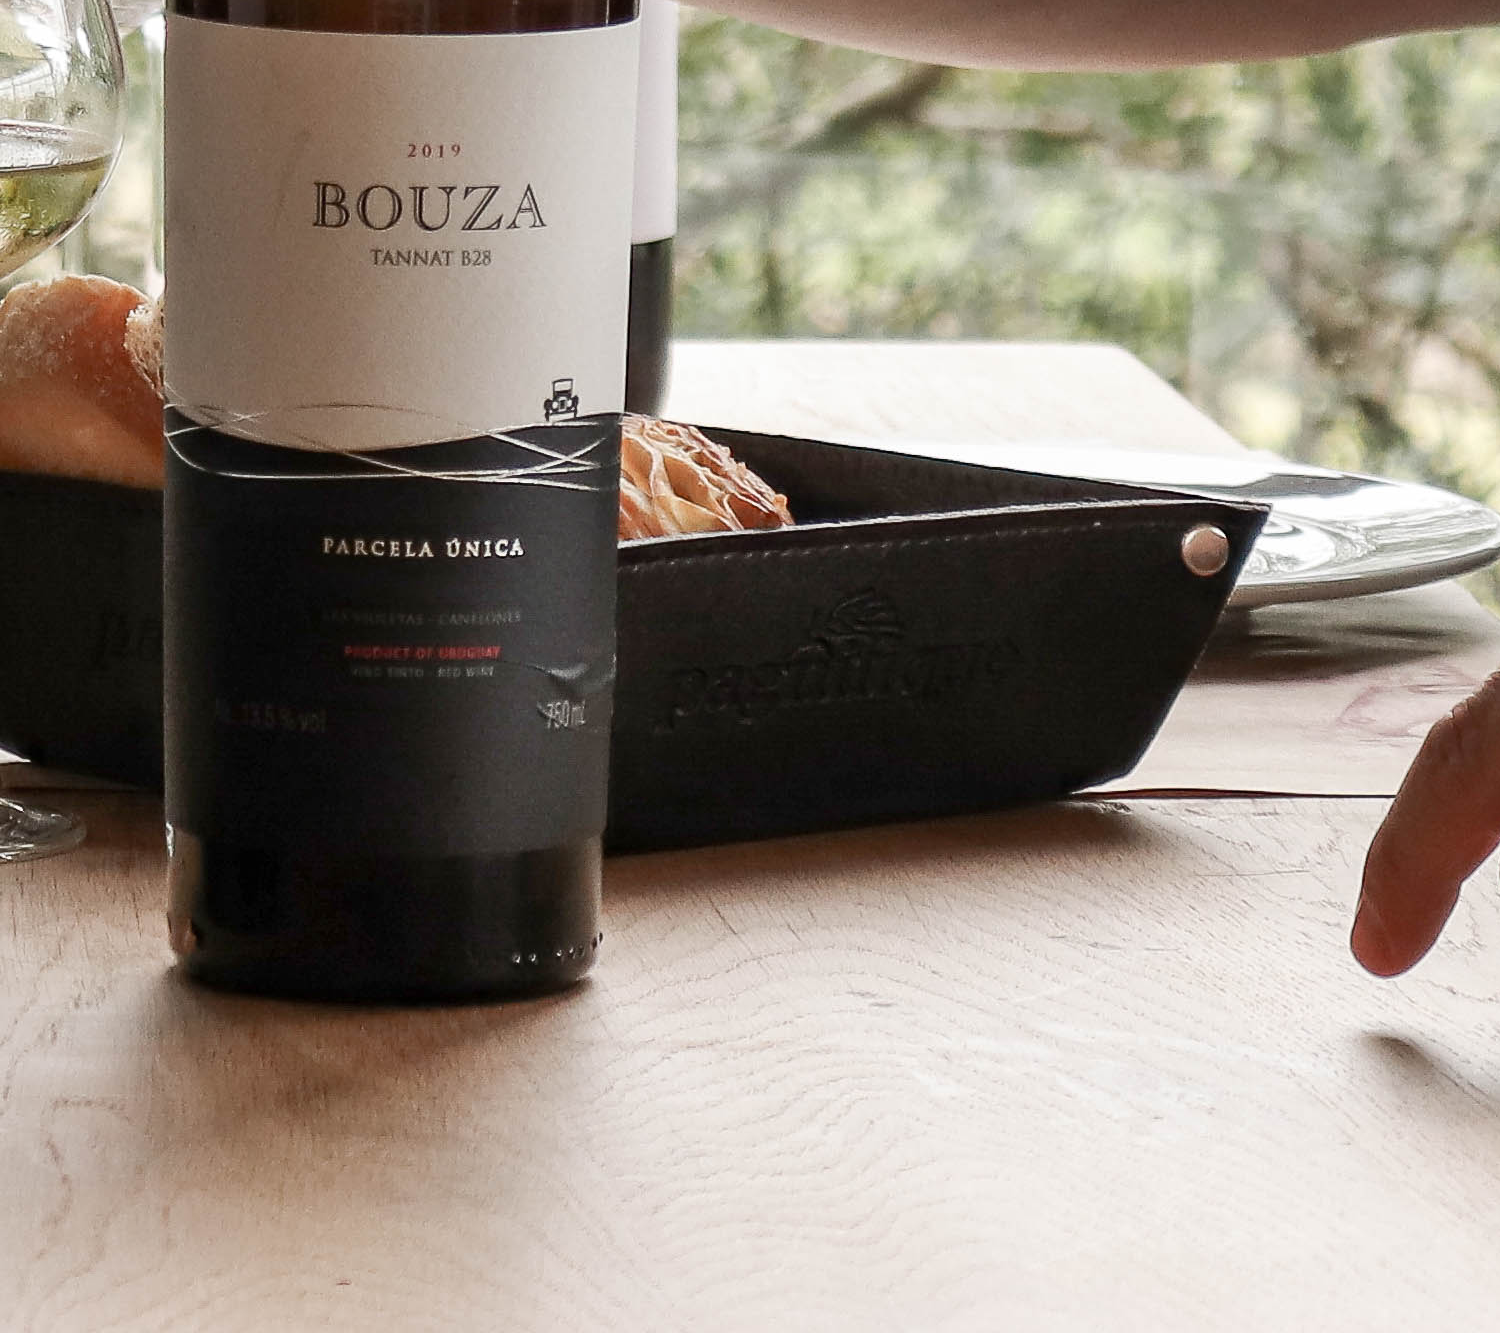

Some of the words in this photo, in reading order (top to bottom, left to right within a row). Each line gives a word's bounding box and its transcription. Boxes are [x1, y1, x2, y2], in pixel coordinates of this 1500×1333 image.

[407, 143, 462, 158] 2019
[312, 181, 548, 232] BOUZA
[370, 248, 454, 267] TANNAT
[461, 249, 492, 267] B28
[323, 537, 434, 558] PARCELA
[446, 537, 525, 558] ÚNICA
